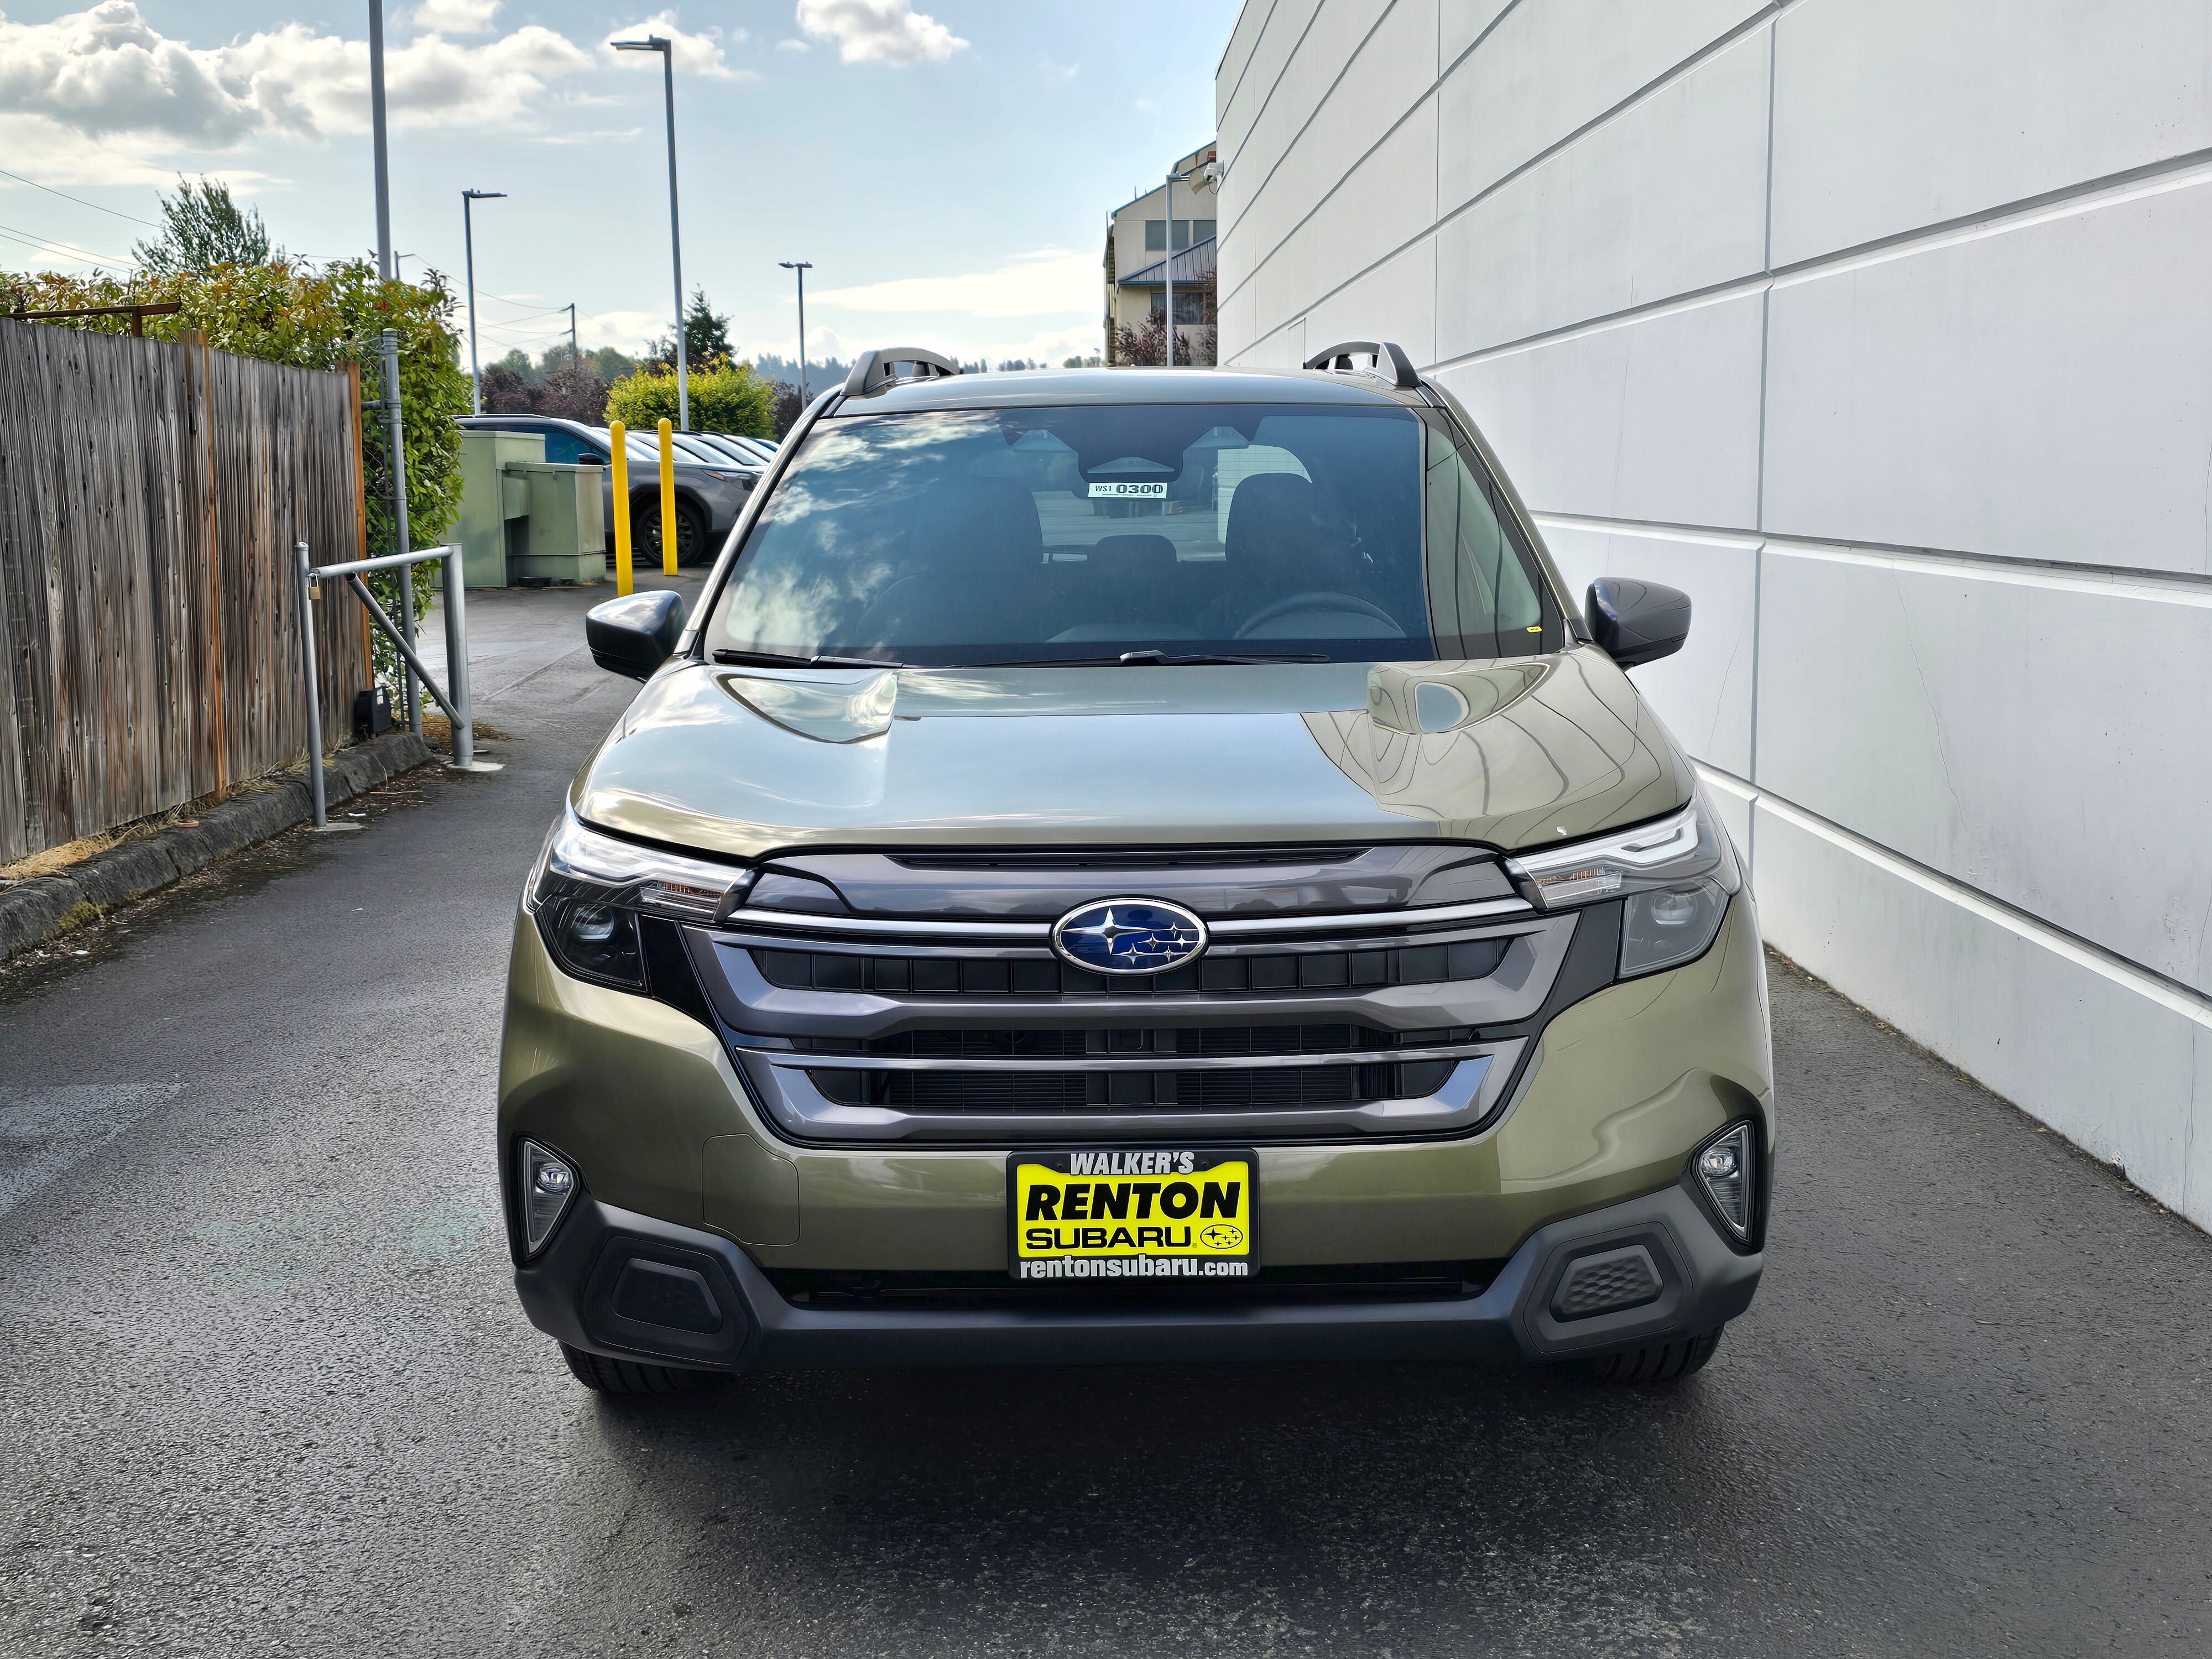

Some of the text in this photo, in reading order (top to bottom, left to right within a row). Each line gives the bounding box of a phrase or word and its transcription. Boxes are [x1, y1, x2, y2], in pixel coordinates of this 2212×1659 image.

[1116, 484, 1163, 494] 0300
[1070, 1152, 1194, 1176] WALKER'S
[1025, 1182, 1241, 1220] RENTON
[1026, 1226, 1191, 1249] SUBARU
[1020, 1254, 1248, 1278] rentonsubaru.com
